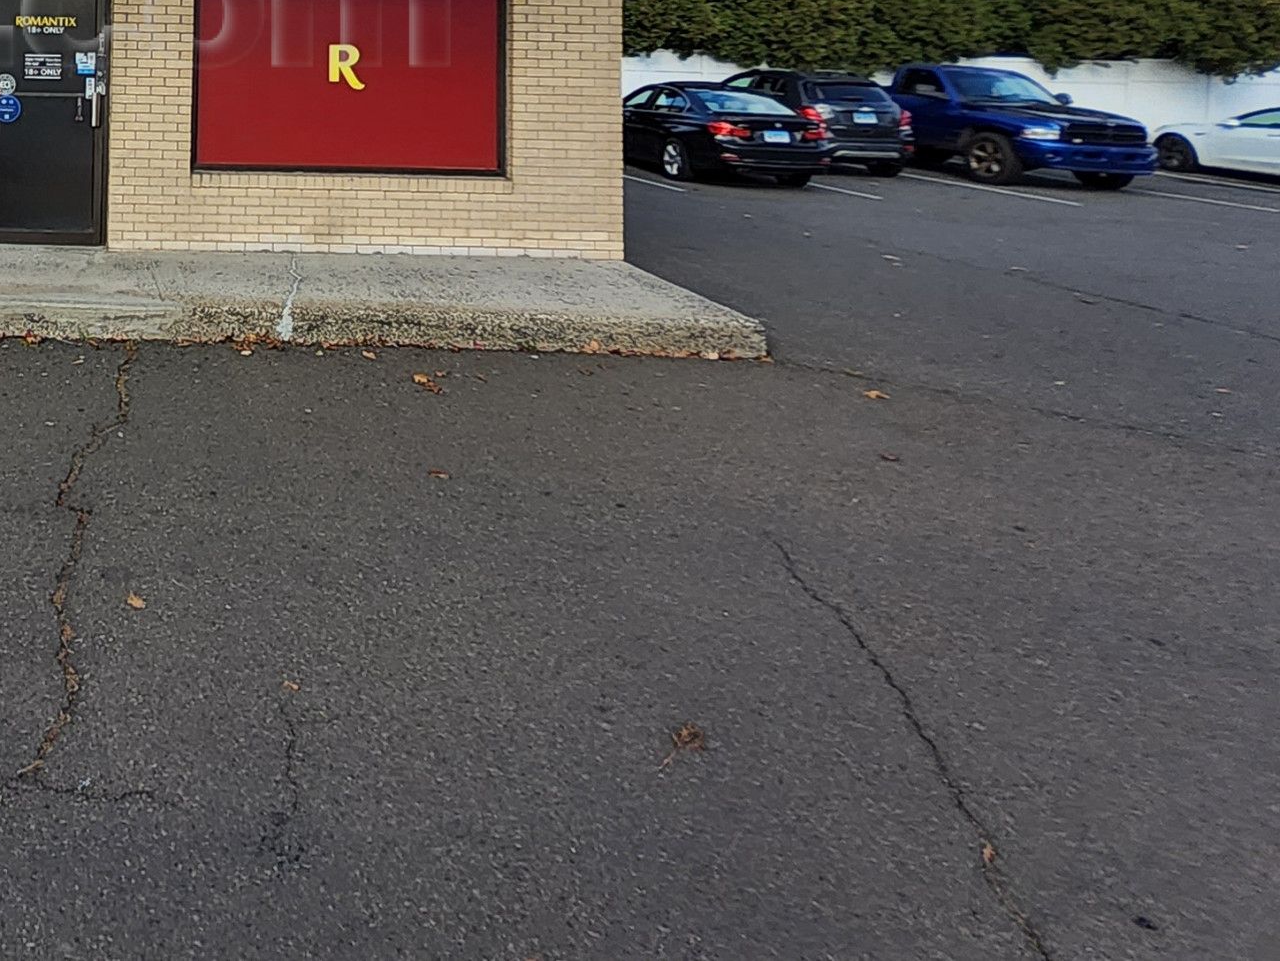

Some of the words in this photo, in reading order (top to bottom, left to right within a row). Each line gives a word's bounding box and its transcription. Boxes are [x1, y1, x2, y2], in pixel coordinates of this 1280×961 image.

[15, 15, 77, 28] ROMANTIX
[43, 26, 65, 34] ONLY
[328, 43, 366, 90] R
[24, 68, 39, 76] 18+
[40, 68, 62, 76] ONLY
